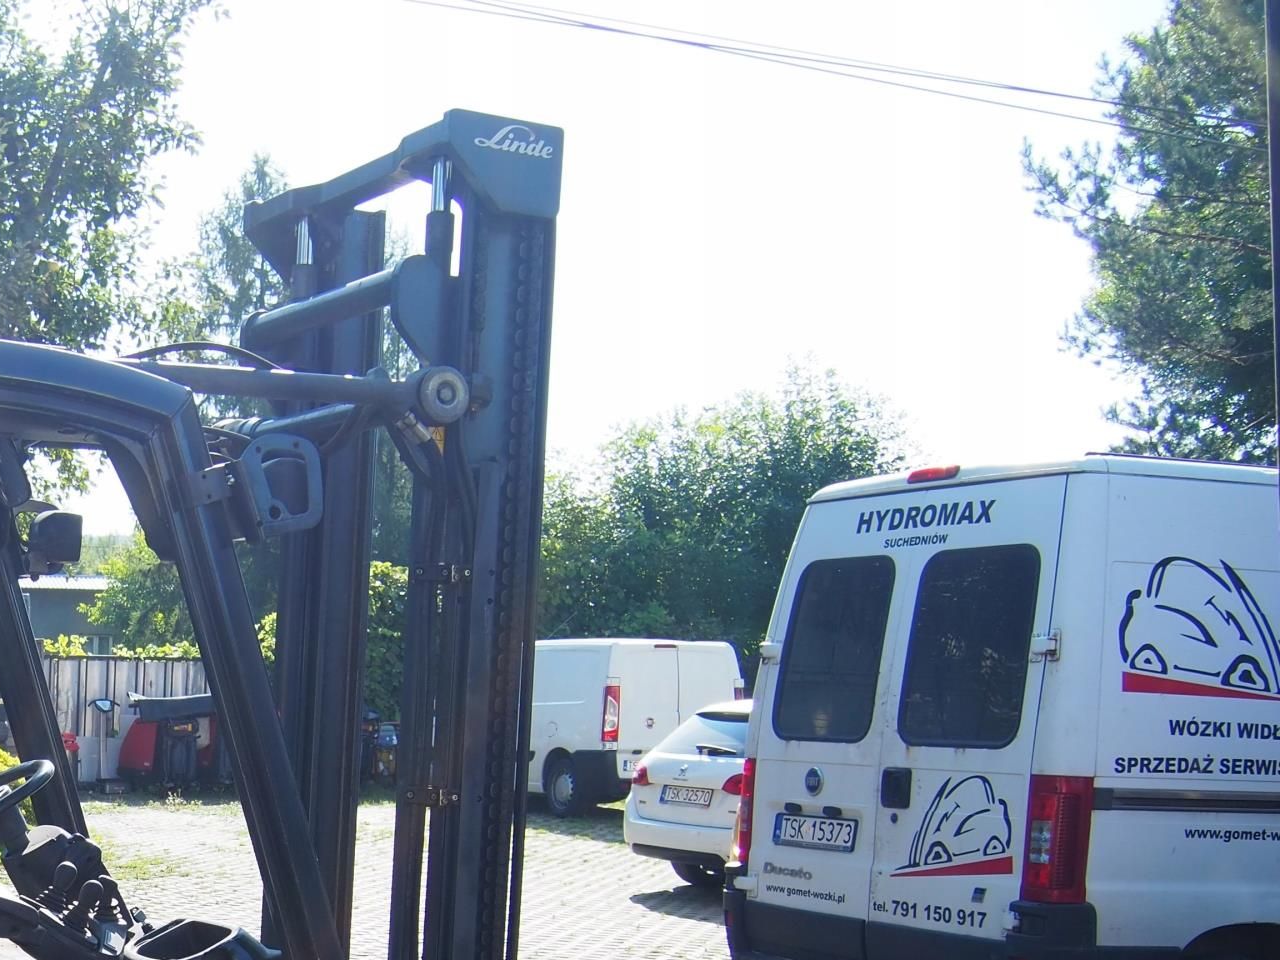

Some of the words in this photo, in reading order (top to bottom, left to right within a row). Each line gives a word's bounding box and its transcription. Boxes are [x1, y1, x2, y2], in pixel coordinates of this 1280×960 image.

[474, 125, 553, 158] Linde
[856, 500, 997, 534] HYDROMAX
[883, 532, 948, 549] SUCHEDNIÓW
[1169, 716, 1231, 738] WÓZKI
[1114, 754, 1214, 774] SPRZEDAŻ
[1219, 758, 1280, 776] SERWI
[666, 787, 681, 801] TSK
[683, 789, 710, 803] 32570
[783, 817, 807, 840] TSK
[811, 821, 853, 844] 15373
[763, 862, 813, 881] Ducato
[766, 884, 846, 904] wwwgomet-wozki.pl
[872, 901, 888, 913] tel.
[892, 900, 917, 919] 791
[924, 904, 952, 924] 150
[957, 909, 987, 928] 917
